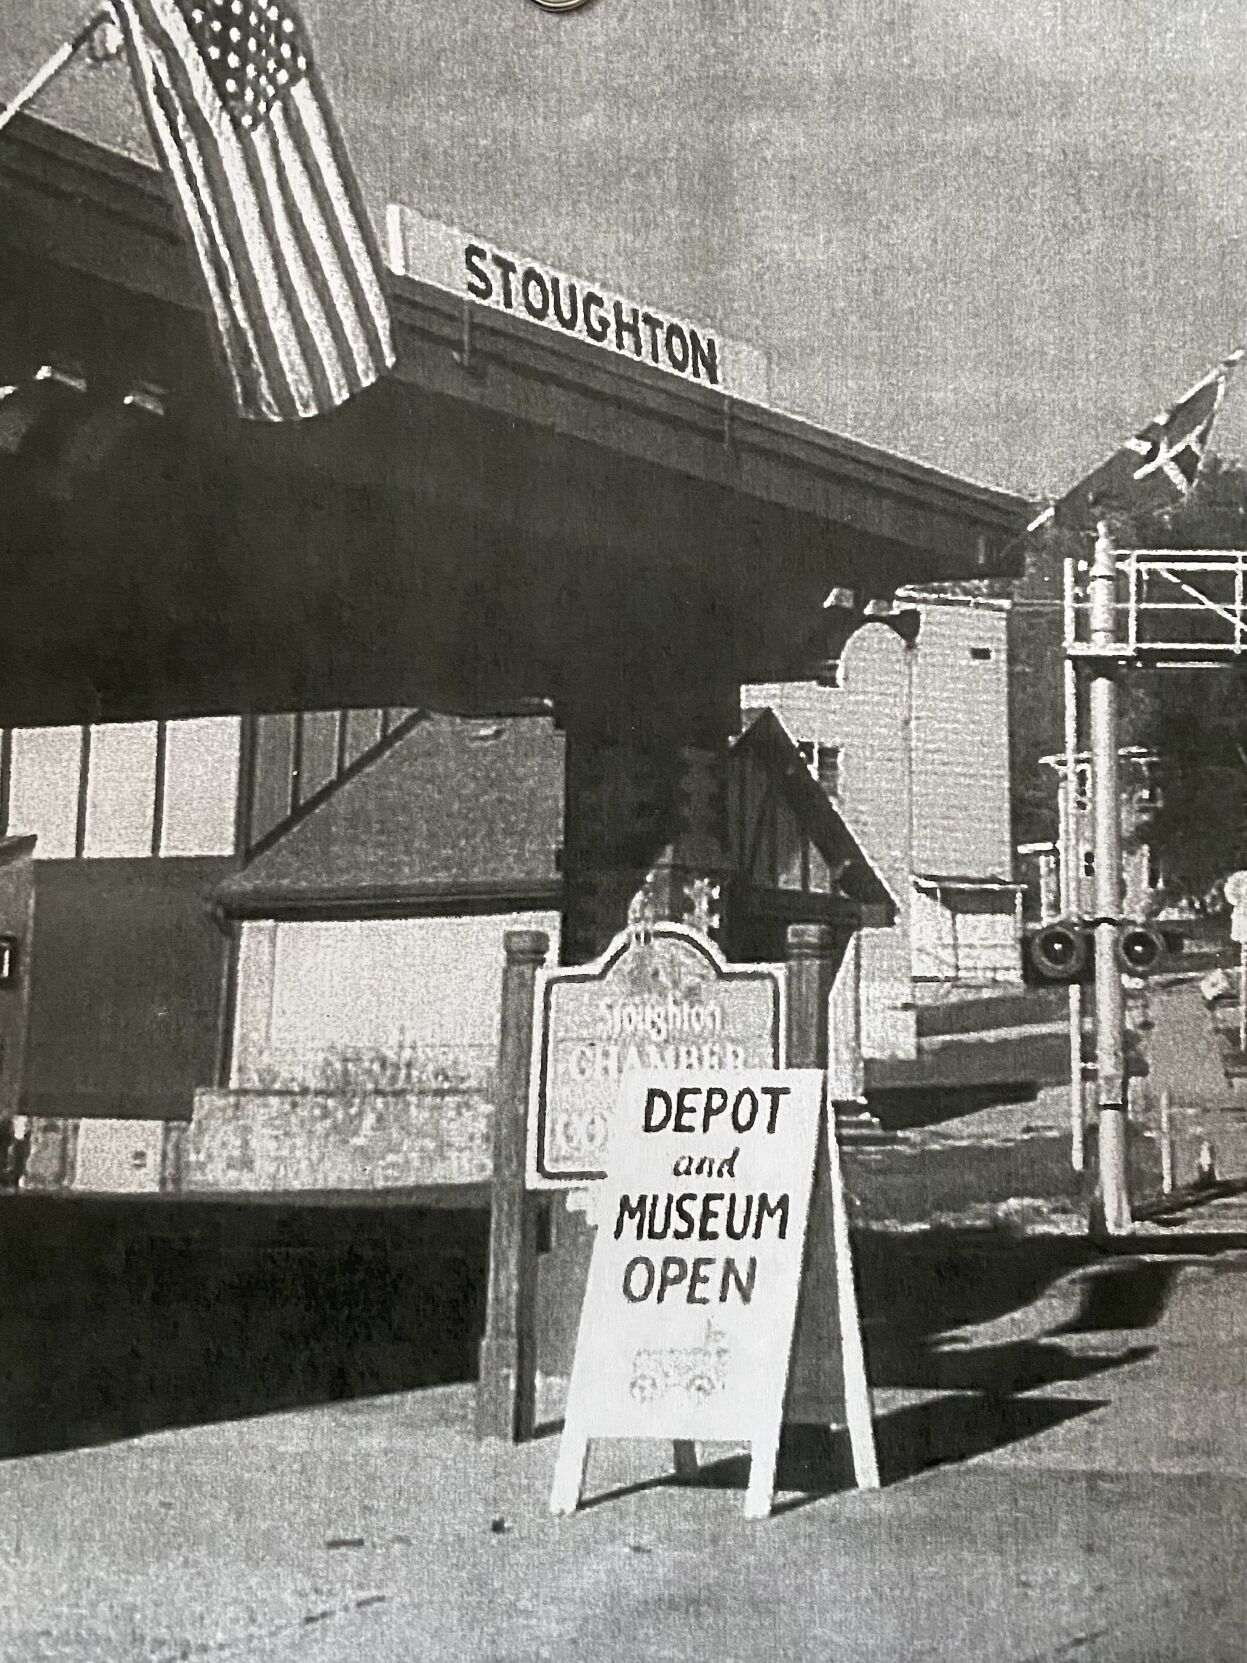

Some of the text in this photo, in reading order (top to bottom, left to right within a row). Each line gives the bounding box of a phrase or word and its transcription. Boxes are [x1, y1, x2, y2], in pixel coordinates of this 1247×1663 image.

[465, 244, 719, 385] STOUGHTON
[643, 1086, 791, 1135] DEPOT
[672, 1147, 740, 1178] and
[613, 1192, 789, 1241] MUSEUM
[622, 1256, 758, 1305] OPEN
